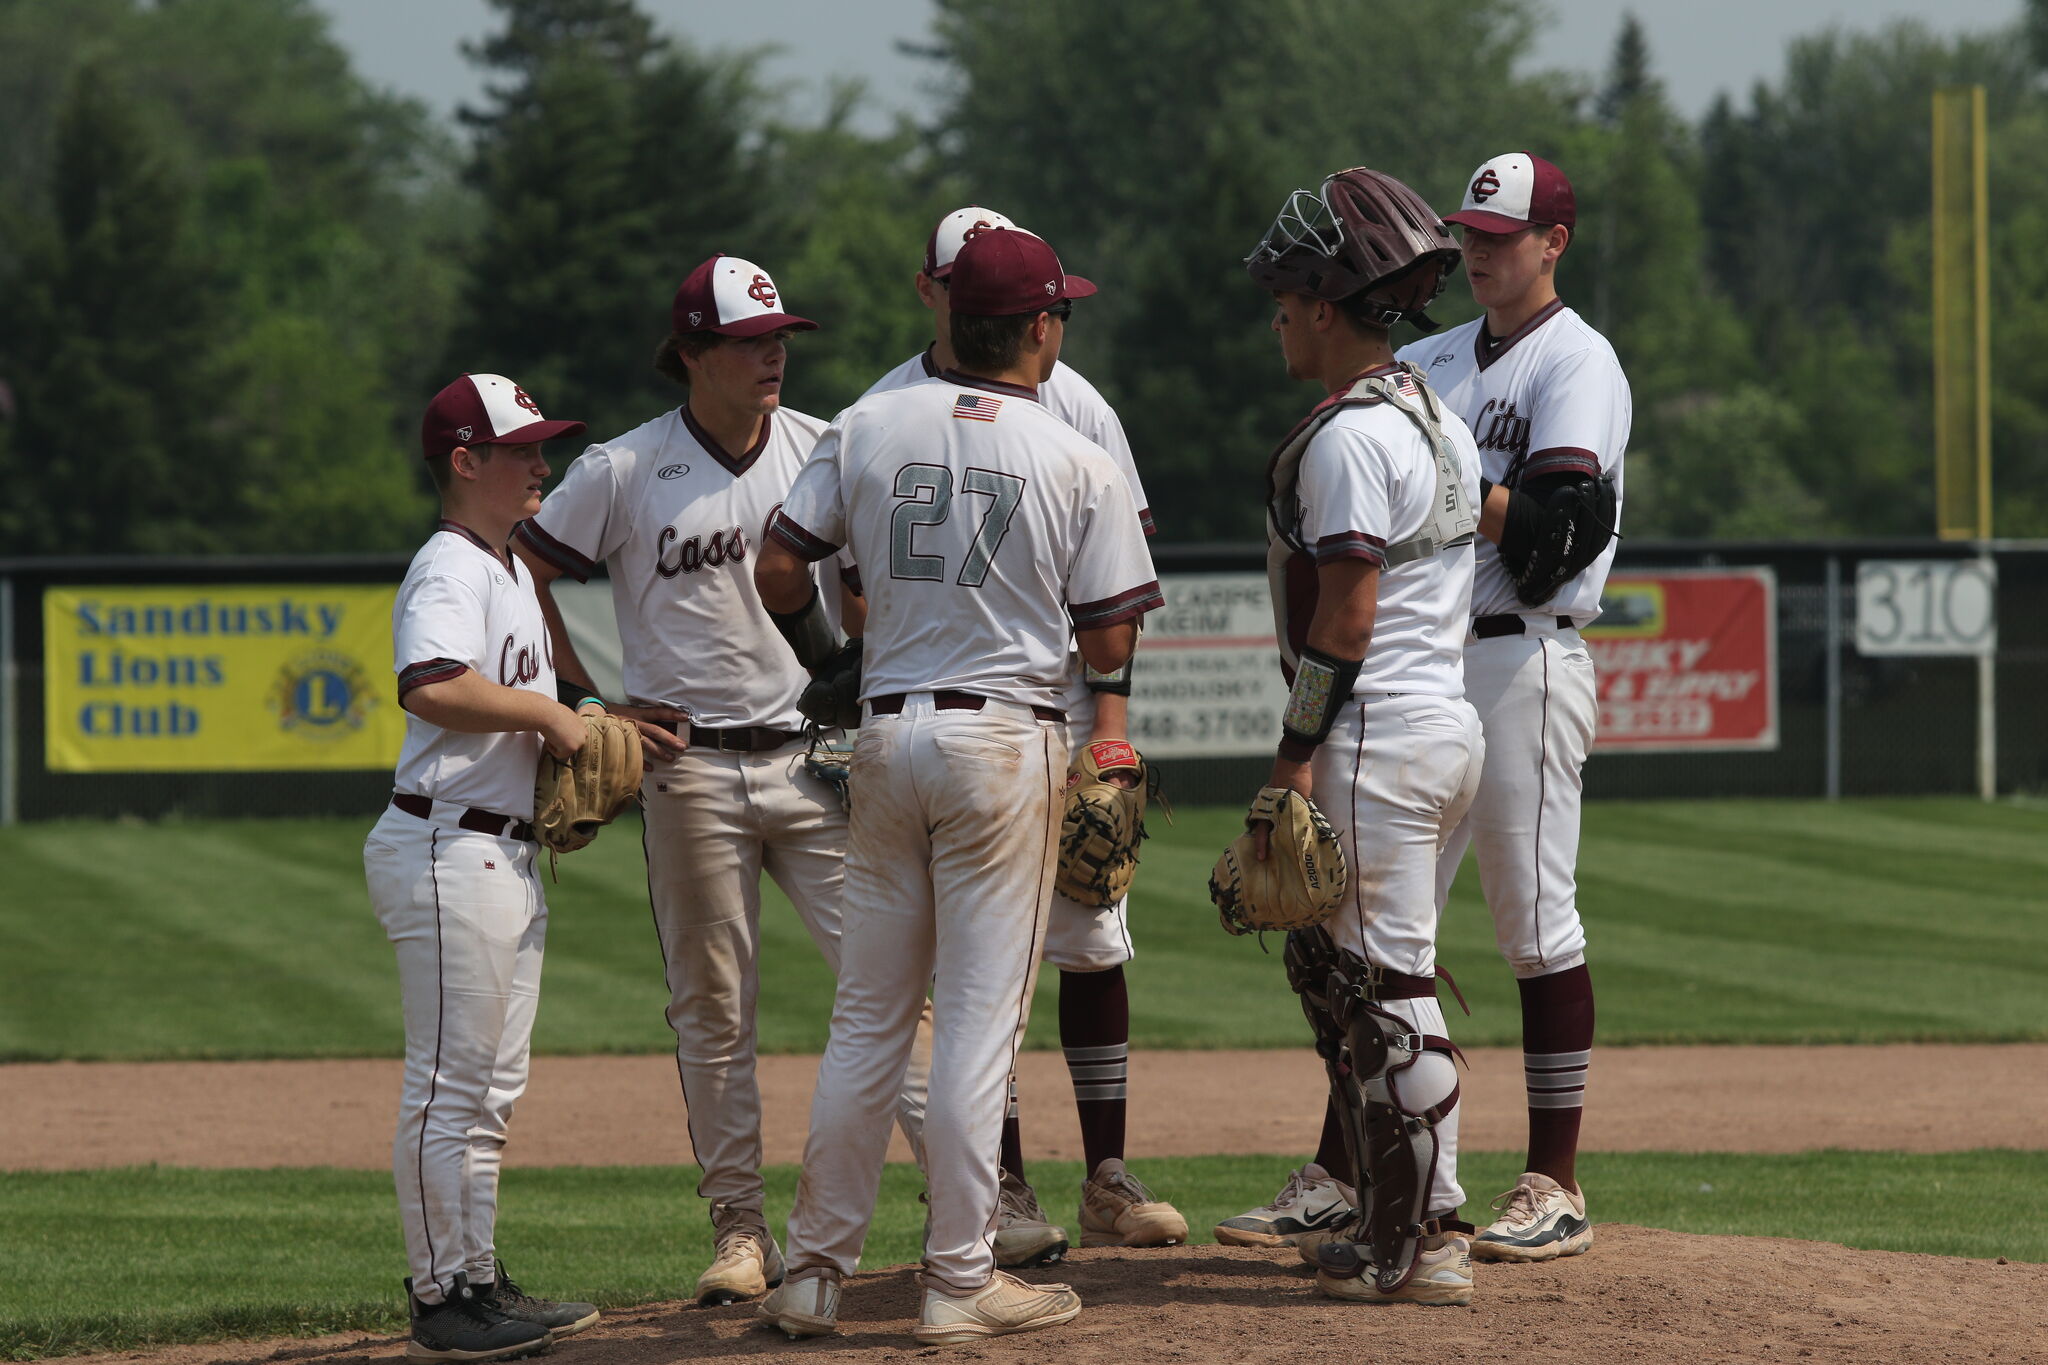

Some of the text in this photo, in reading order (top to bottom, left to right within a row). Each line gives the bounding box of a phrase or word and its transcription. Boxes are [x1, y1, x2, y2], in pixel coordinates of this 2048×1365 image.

[890, 462, 1026, 588] 27
[655, 523, 750, 580] Cass
[76, 596, 344, 638] Sandusky
[1862, 564, 1995, 645] 310
[77, 650, 226, 688] Lions
[77, 699, 202, 738] Club
[1303, 853, 1321, 890] A2000
